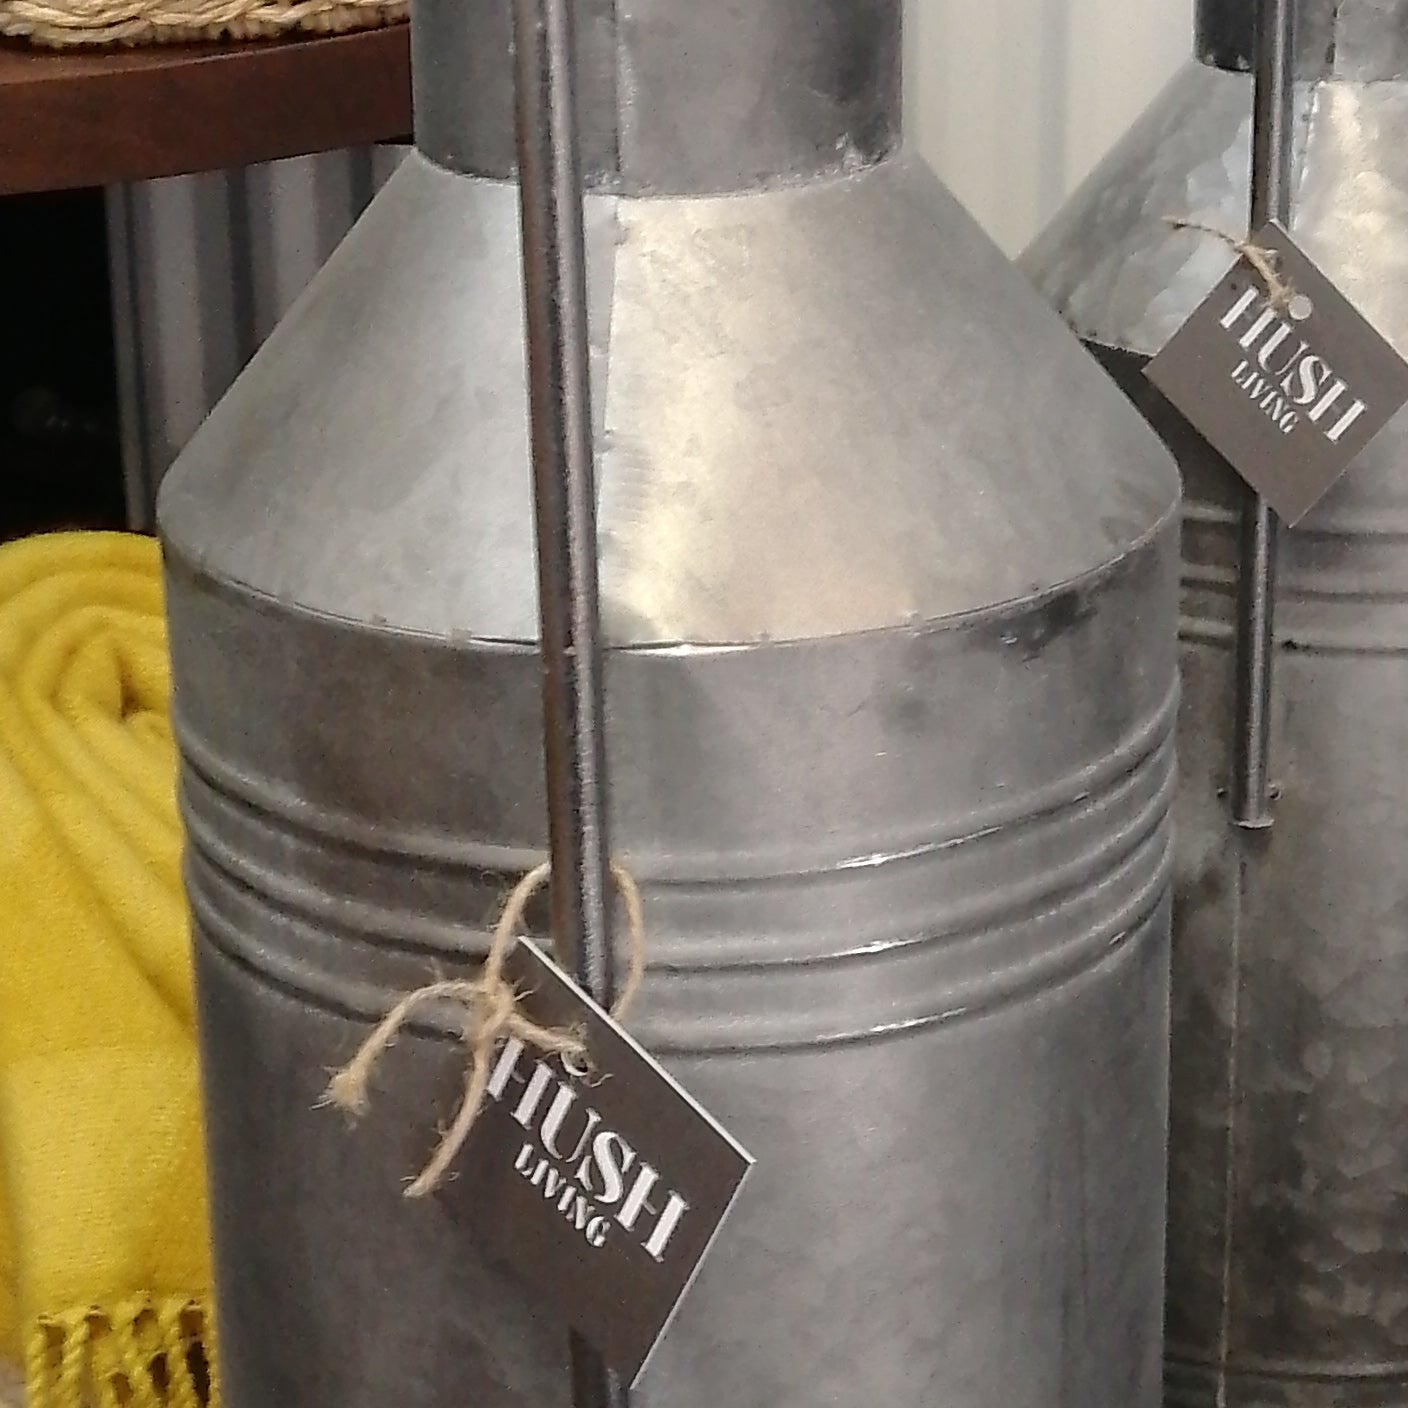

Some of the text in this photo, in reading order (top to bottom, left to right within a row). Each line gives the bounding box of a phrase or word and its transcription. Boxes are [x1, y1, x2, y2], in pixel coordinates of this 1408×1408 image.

[1218, 286, 1367, 443] HUSH
[1230, 359, 1299, 435] LIVING
[486, 1036, 690, 1263] HUSH
[513, 1143, 612, 1248] LIVING
